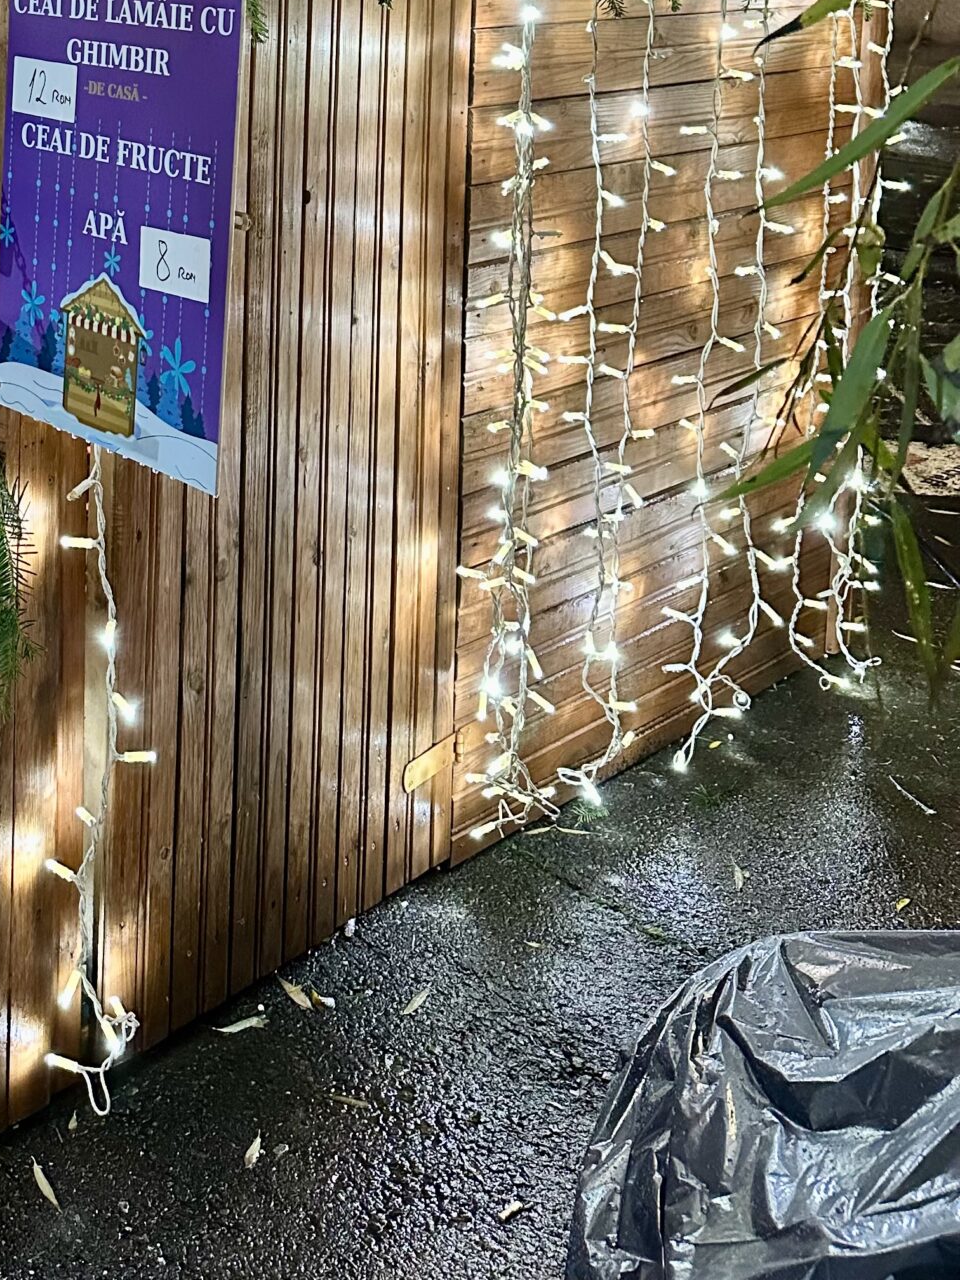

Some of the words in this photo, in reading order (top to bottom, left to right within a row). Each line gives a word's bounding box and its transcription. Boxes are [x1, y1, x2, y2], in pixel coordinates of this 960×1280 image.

[200, 6, 236, 36] CU
[66, 38, 171, 77] GHIMBIR
[29, 68, 47, 105] 12
[21, 122, 74, 156] CEAI
[78, 132, 111, 164] DE
[116, 139, 212, 185] FRUCTE
[82, 209, 129, 245] APĂ
[157, 239, 171, 282] 8
